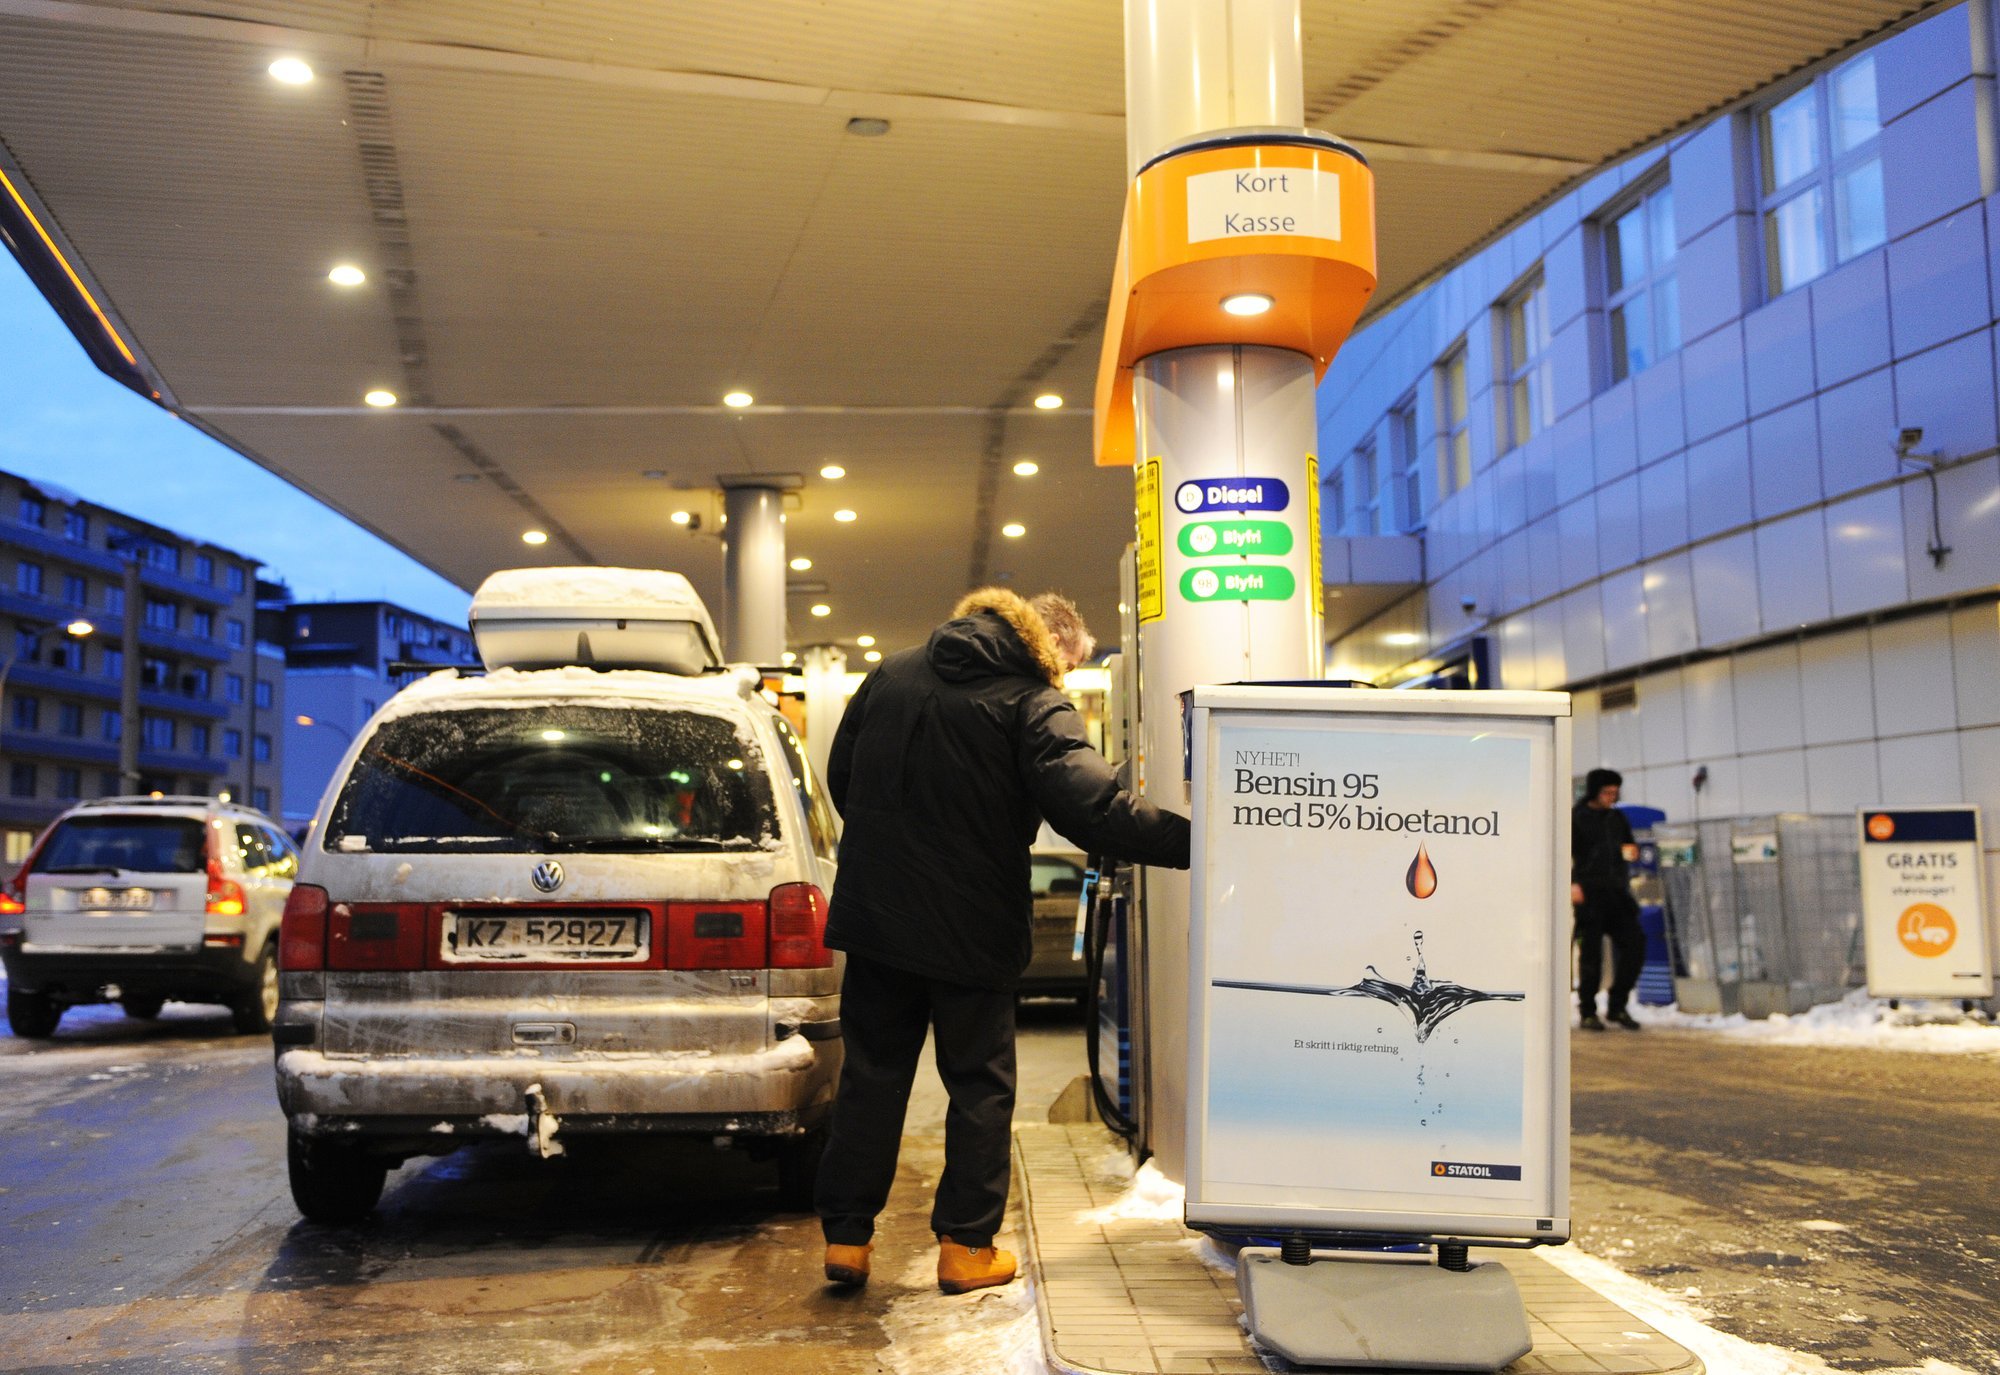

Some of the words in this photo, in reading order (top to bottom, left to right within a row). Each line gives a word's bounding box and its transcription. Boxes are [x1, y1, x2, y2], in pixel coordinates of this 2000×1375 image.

[1236, 173, 1288, 193] Kort
[1225, 213, 1295, 234] Kasse
[1207, 485, 1263, 505] Diesel
[1235, 750, 1300, 767] NYHET!
[1234, 768, 1337, 798] Bensin
[1343, 773, 1379, 799] 95
[1233, 802, 1303, 828] med
[1307, 803, 1351, 830] 5%
[1355, 804, 1500, 837] bioetanol
[1886, 852, 1957, 869] GRATIS
[467, 920, 507, 948] KZ
[526, 920, 626, 946] 52927
[1294, 1039, 1304, 1048] Et
[1305, 1040, 1330, 1050] skritt
[1337, 1042, 1362, 1053] riktig
[1364, 1044, 1399, 1055] retning
[1447, 1165, 1492, 1177] STATOIL
